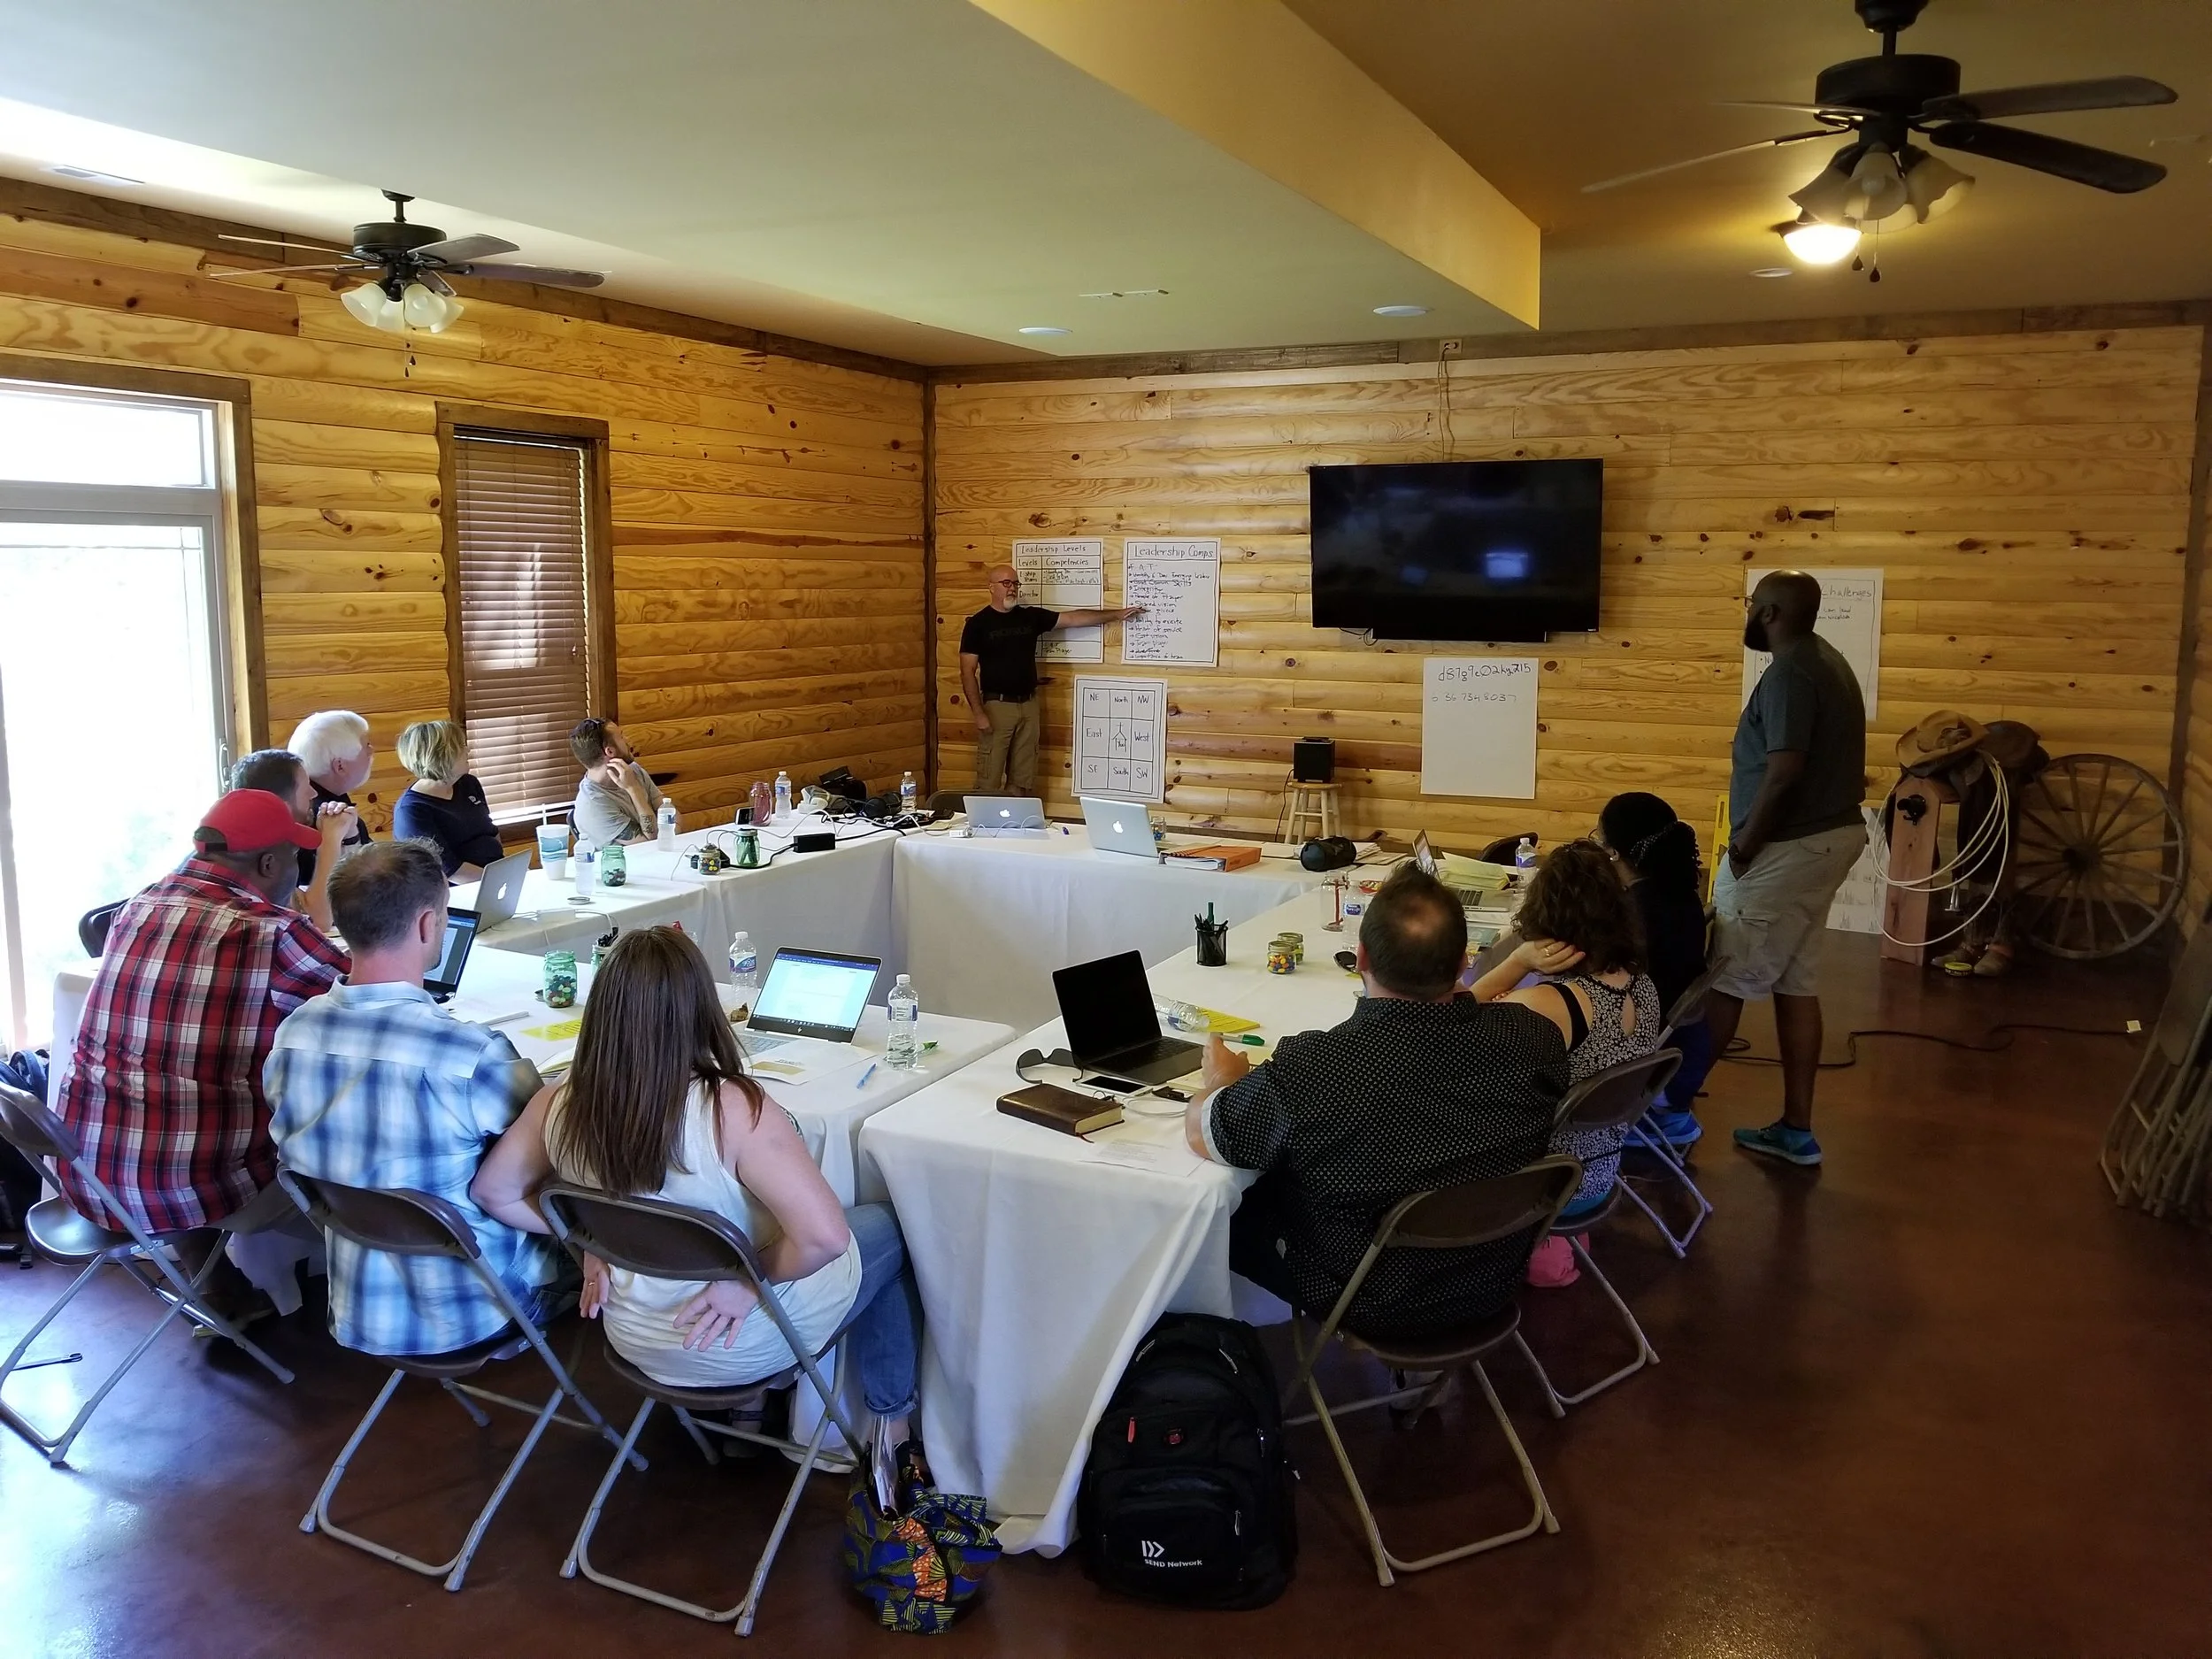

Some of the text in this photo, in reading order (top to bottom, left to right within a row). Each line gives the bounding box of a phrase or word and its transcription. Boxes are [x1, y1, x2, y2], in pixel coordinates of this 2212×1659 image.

[1021, 544, 1059, 555] Leadership
[1134, 544, 1214, 559] Leadership Comps
[1018, 558, 1038, 567] Levels
[1045, 557, 1089, 567] Competencies
[1089, 692, 1100, 702] NE
[1137, 695, 1150, 704] NW
[1086, 727, 1102, 738] East
[1133, 731, 1150, 742] West
[1087, 764, 1098, 773] SE
[1112, 766, 1129, 776] South
[1136, 767, 1148, 780] SW
[1144, 1558, 1203, 1568] SEND Network
